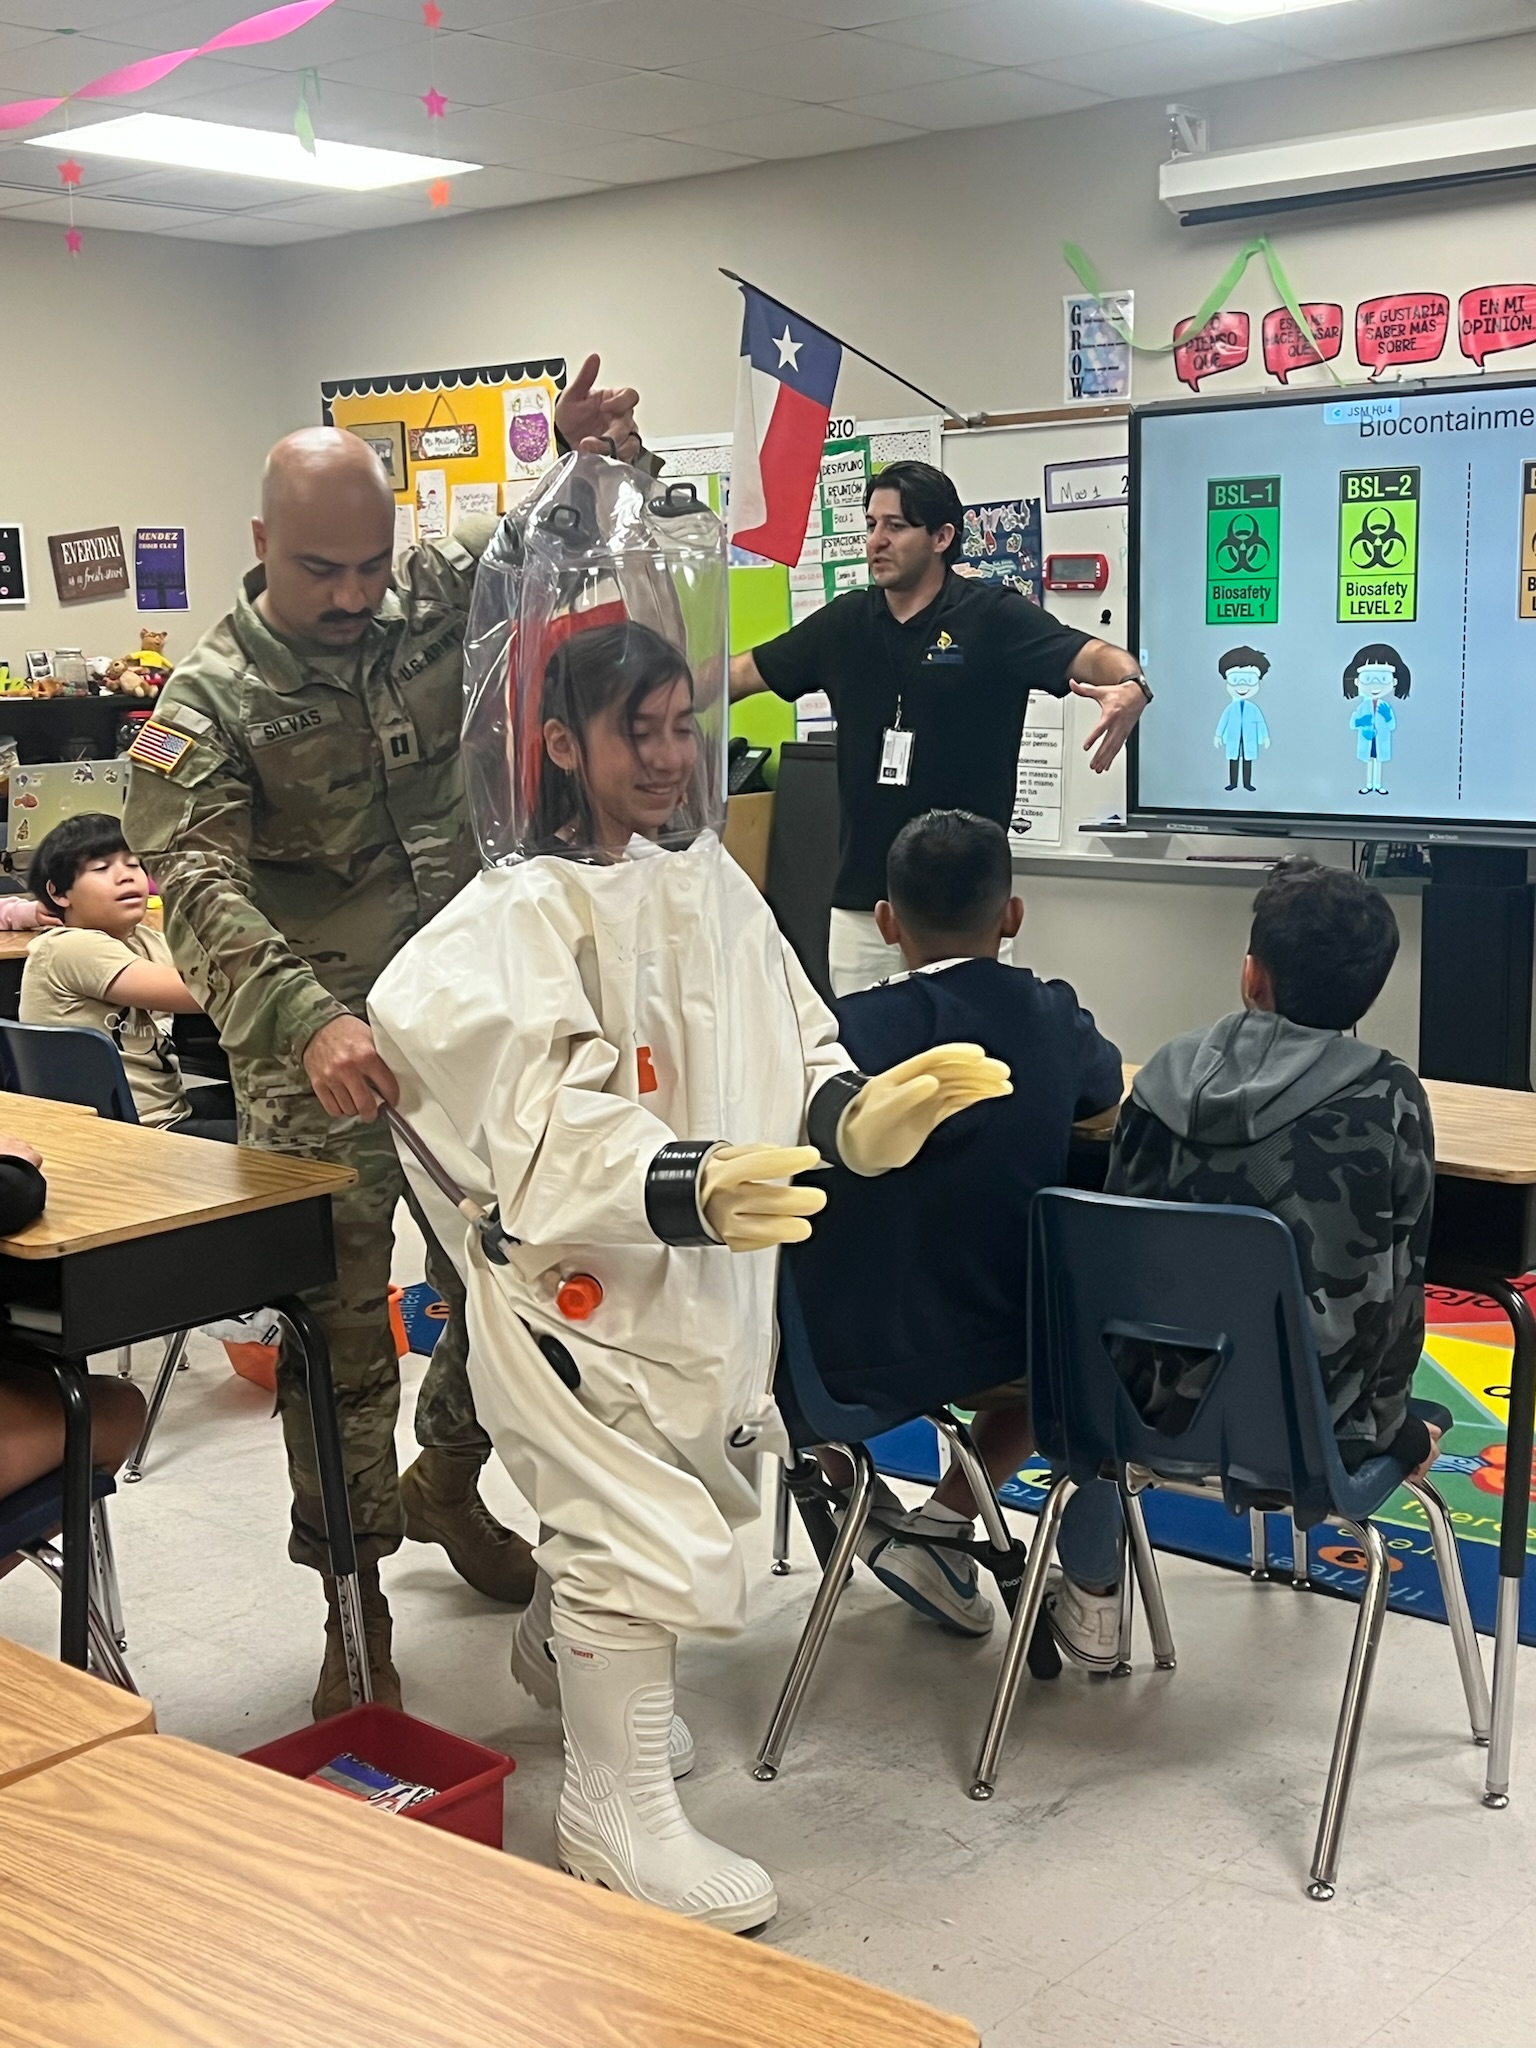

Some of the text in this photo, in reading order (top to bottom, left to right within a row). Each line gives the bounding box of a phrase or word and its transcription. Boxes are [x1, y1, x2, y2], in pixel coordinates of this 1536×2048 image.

[1480, 295, 1525, 316] EN MI
[1366, 324, 1406, 341] SABER
[821, 458, 864, 476] DESAYUNO
[827, 480, 863, 498] REUNIÓN
[1060, 481, 1087, 504] May
[1092, 485, 1102, 500] 1
[1214, 482, 1274, 506] BSL-1
[1346, 474, 1413, 500] BSL-2
[138, 532, 179, 541] MENDEZ
[822, 533, 868, 549] ESTACIONES
[61, 534, 123, 566] EVERYDAY
[82, 565, 105, 591] fresh
[1213, 585, 1272, 602] Biosafety
[1346, 581, 1409, 598] Biosafety
[1217, 603, 1266, 618] LEVEL 1
[1350, 600, 1403, 616] LEVEL 2
[264, 709, 322, 741] SILVAS
[1033, 731, 1049, 740] lugar
[1034, 780, 1055, 788] mismo
[104, 1012, 155, 1038] Calvin
